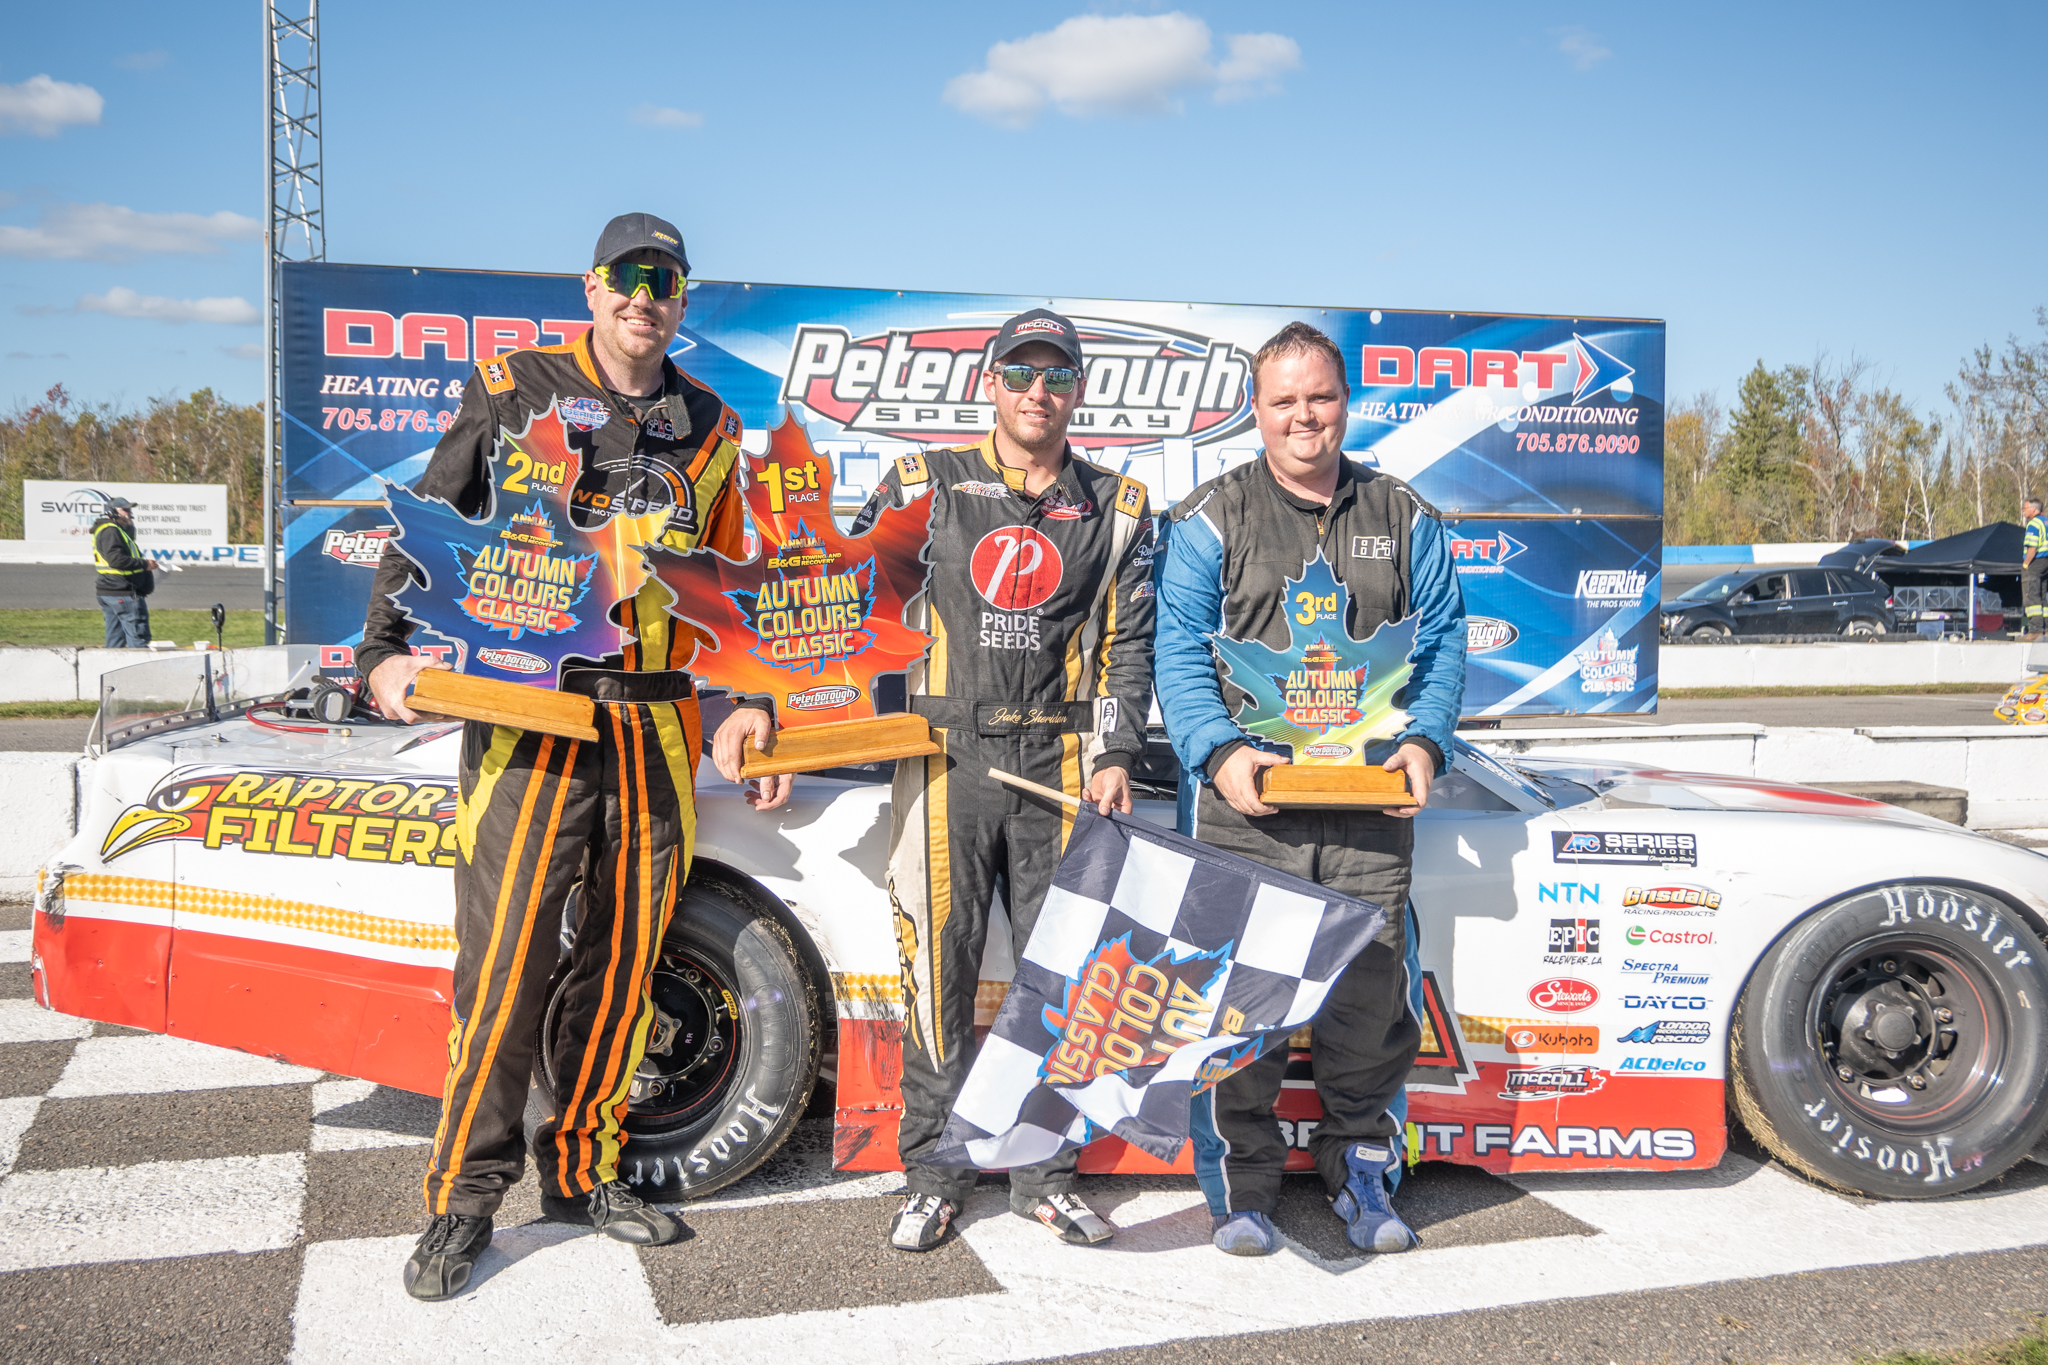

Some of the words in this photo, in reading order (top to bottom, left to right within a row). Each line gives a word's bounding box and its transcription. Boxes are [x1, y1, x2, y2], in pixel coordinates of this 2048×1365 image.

[783, 328, 1245, 412] Peterough
[1362, 344, 1568, 390] DART
[320, 374, 440, 398] HEATING
[443, 379, 465, 398] &
[321, 407, 451, 431] 705.876.9
[564, 408, 605, 421] SERIES
[876, 407, 1170, 428] SPEWAY
[1358, 401, 1445, 419] HEATING
[1504, 404, 1639, 425] CONDITIONING
[1516, 432, 1640, 454] 705.876.9090
[501, 451, 568, 494] 2nd
[530, 482, 559, 495] PLACE
[757, 461, 821, 514] 1st
[41, 501, 108, 513] SWITC
[788, 492, 820, 503] PLACE
[151, 504, 175, 512] BRANDS
[175, 504, 188, 512] YOU
[160, 515, 181, 523] ADVICE
[511, 513, 555, 529] ANNUAL
[153, 528, 174, 536] PRICES
[174, 528, 212, 536] GUARANTEED
[499, 529, 530, 542] B&G
[527, 539, 558, 549] RECOVERY
[780, 536, 825, 550] ANNUAL
[1451, 539, 1497, 559] RT
[472, 544, 577, 587] AUTUMN
[767, 556, 801, 569] B&G
[801, 558, 835, 566] RECOVERY
[469, 571, 573, 612] COLOURS
[756, 573, 860, 611] AUTUMN
[1295, 591, 1338, 626] 3rd
[1586, 600, 1600, 608] THE
[1600, 600, 1618, 608] PROS
[1618, 600, 1641, 608] KNOW
[476, 598, 560, 630] CLASSIC
[757, 602, 863, 640] COLOURS
[981, 611, 1040, 634] PRIDE
[771, 631, 855, 661] CLASSIC
[979, 631, 1041, 650] SEEDS
[1304, 644, 1337, 652] ANNUAL
[479, 648, 545, 669] Peterborough
[1582, 649, 1636, 662] AUTUMN
[1285, 670, 1357, 690] AUTUMN
[1582, 662, 1636, 680] COLOURS
[789, 687, 855, 705] Peterborough
[1581, 680, 1635, 693] CLASSIC
[1285, 689, 1357, 708] COLOURS
[988, 707, 1022, 726] Jake
[1293, 708, 1351, 724] CLASSIC
[216, 773, 447, 816] RAPTOR
[204, 806, 459, 866] FILTERS
[1562, 833, 1601, 853] APC
[1604, 833, 1696, 850] SERIES
[1647, 848, 1696, 856] MODEL
[1538, 881, 1600, 905] NTN
[1622, 887, 1722, 911] Grisdale
[1623, 908, 1660, 916] RACING
[1662, 909, 1716, 917] PRODUCTS
[1548, 924, 1600, 947] EPIC
[1879, 884, 2032, 970] Hoosier
[1649, 929, 1713, 945] Castrol
[1543, 955, 1603, 966] RACEWEAR.CA
[1534, 980, 1592, 1007] Stewart's
[1624, 995, 1706, 1010] DAYCO
[1092, 963, 1170, 1078] COLOU
[1538, 1033, 1593, 1047] Kubota
[1618, 1057, 1707, 1071] ACDelco
[1510, 1073, 1589, 1087] McCOLL
[627, 1084, 781, 1188] Hoosier
[1474, 1124, 1696, 1159] FARMS
[1803, 1097, 1957, 1183] Hoosier
